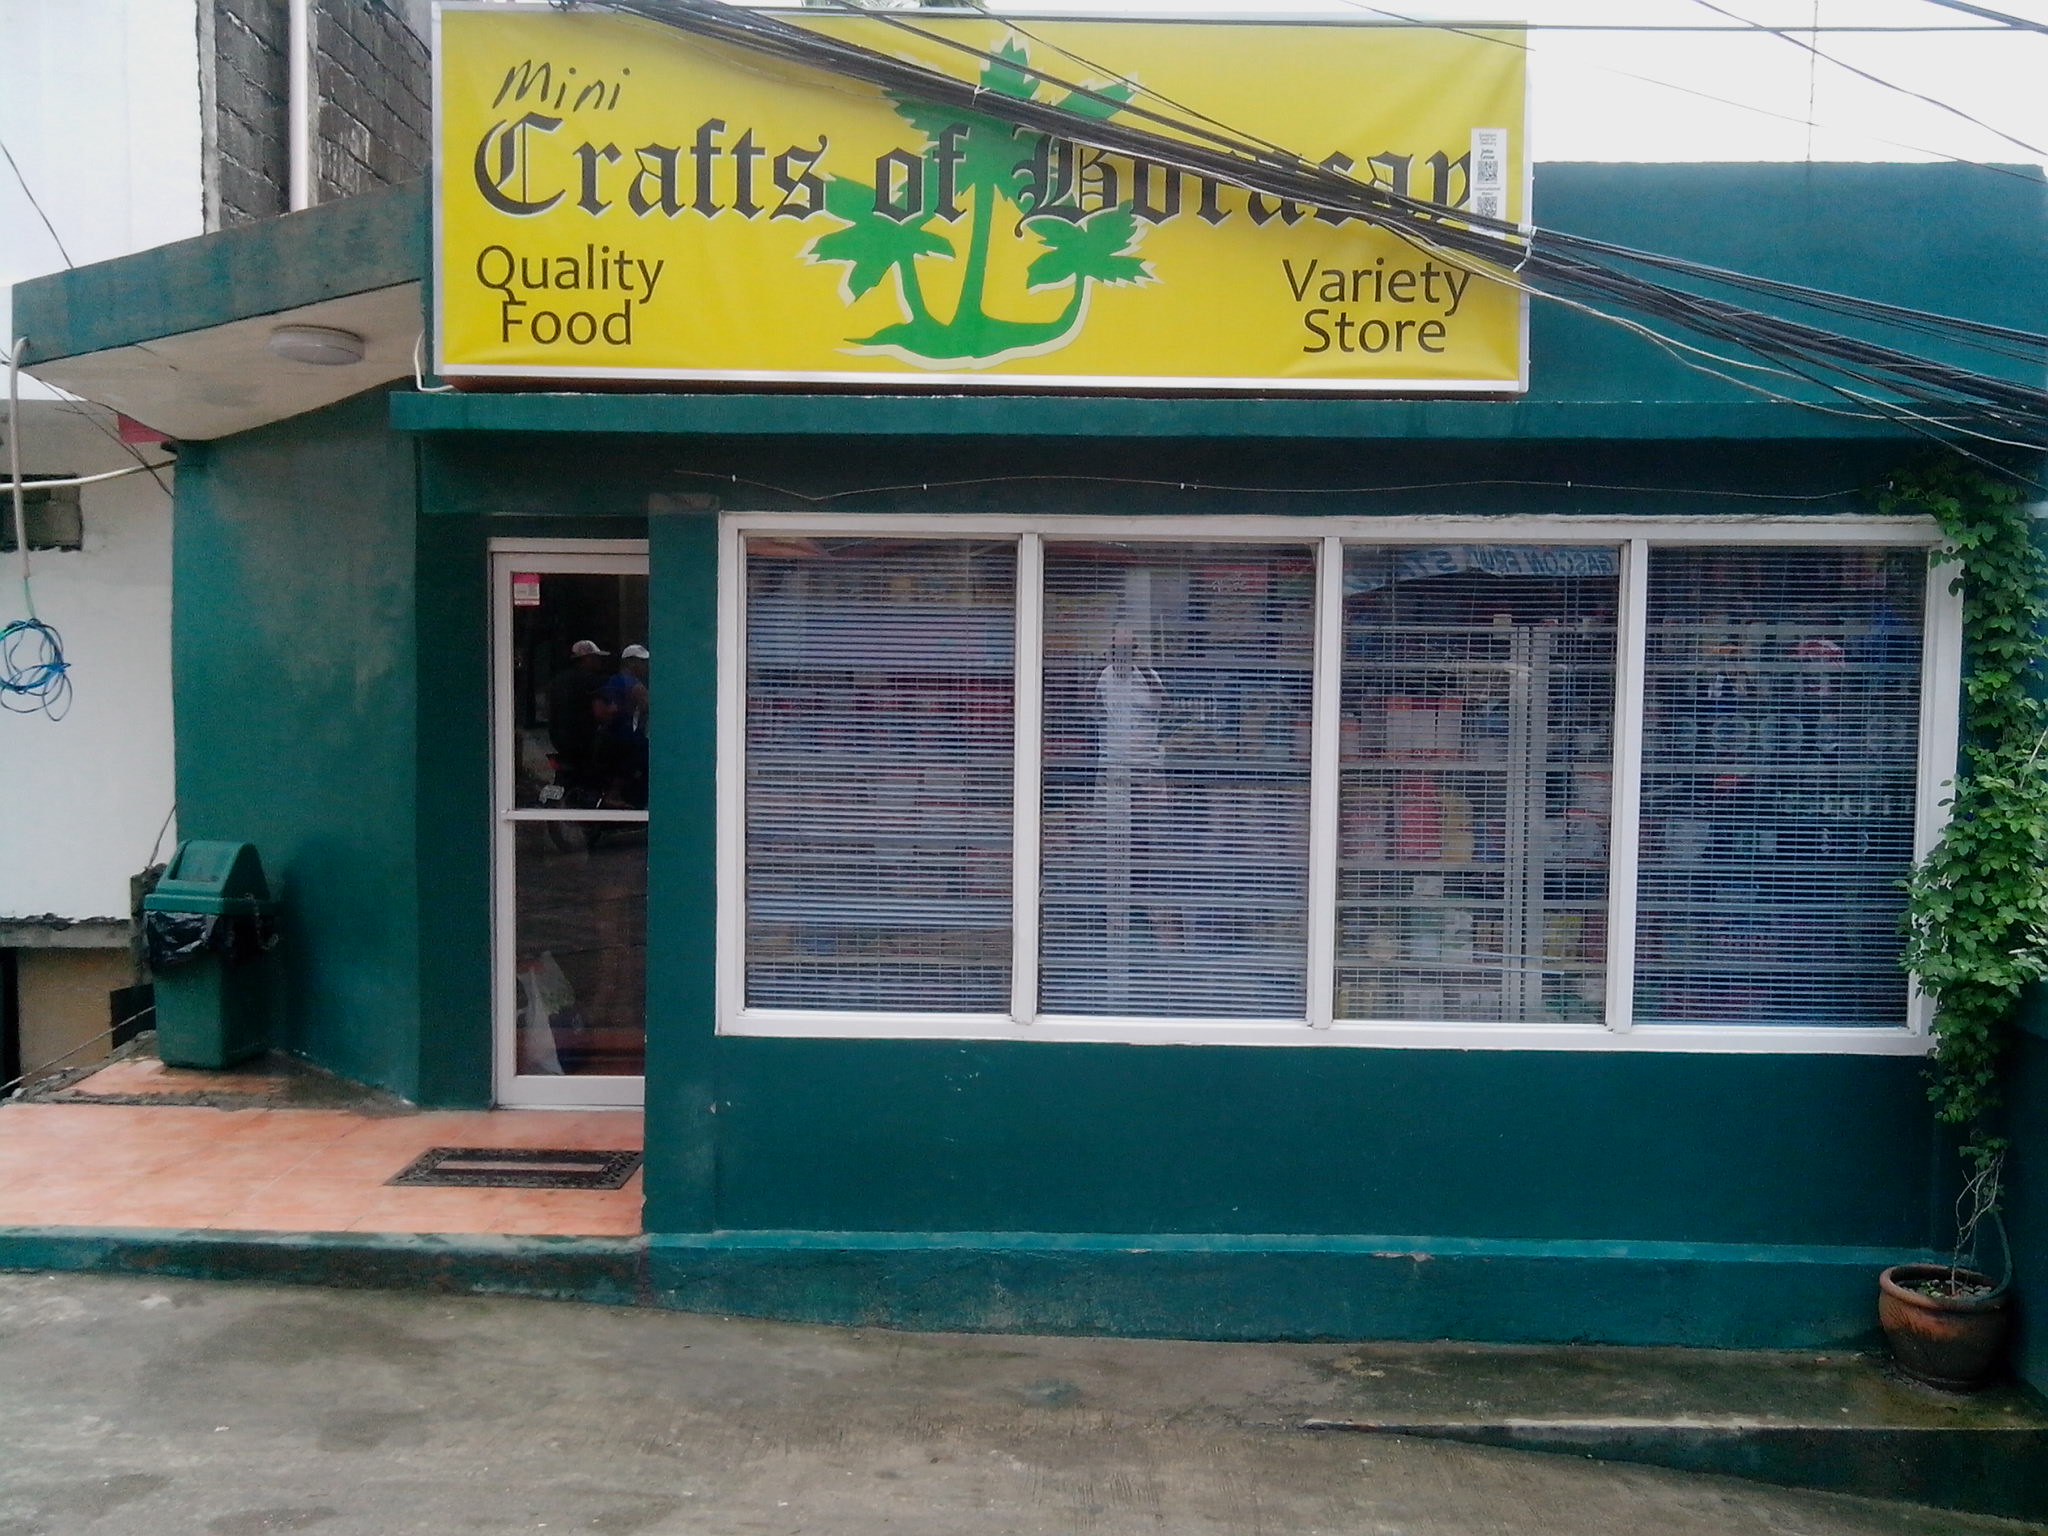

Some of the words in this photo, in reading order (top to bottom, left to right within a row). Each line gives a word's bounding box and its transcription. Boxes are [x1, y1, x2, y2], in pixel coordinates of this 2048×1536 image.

[492, 59, 630, 111] Mini
[473, 112, 829, 221] Crafts
[873, 124, 971, 223] of
[476, 243, 664, 305] Quality
[1282, 257, 1471, 316] Variety
[501, 299, 632, 345] Food
[1303, 308, 1446, 353] Store
